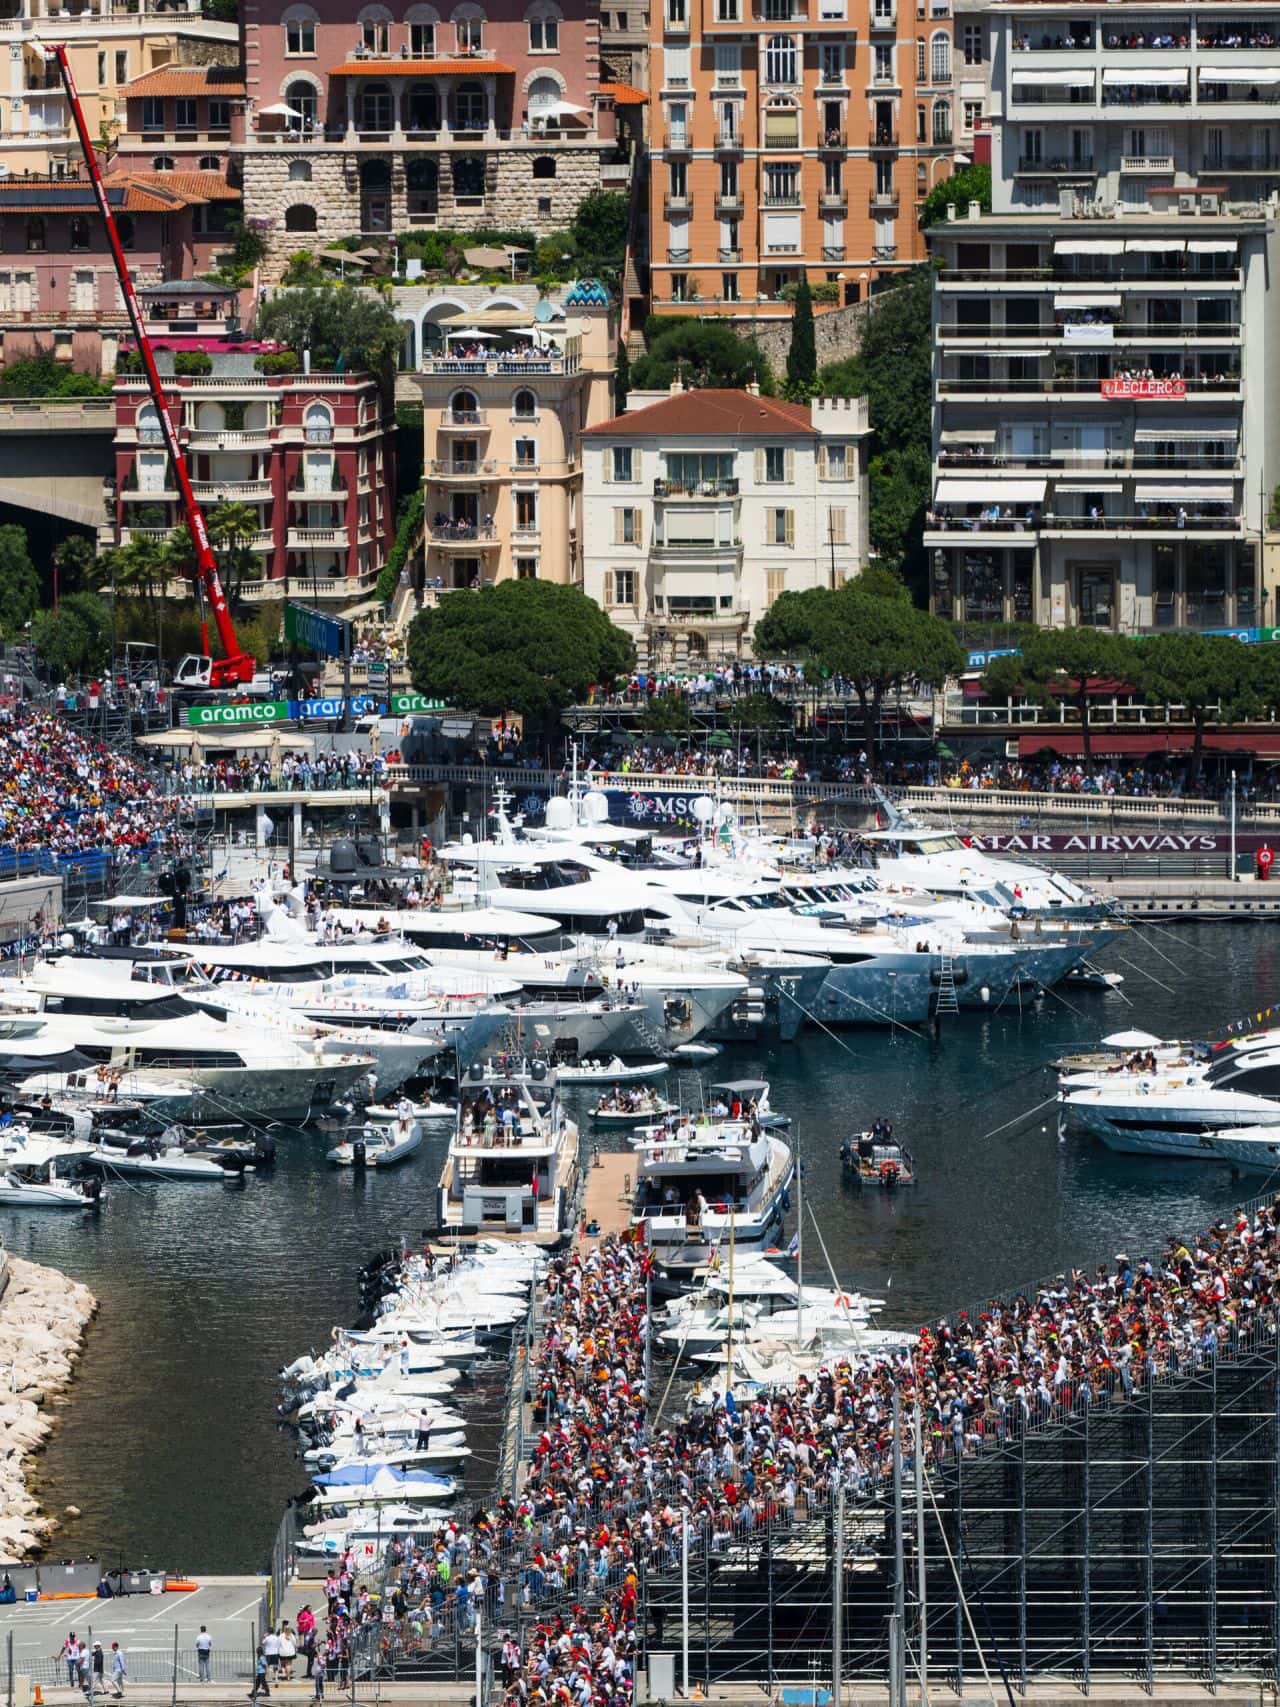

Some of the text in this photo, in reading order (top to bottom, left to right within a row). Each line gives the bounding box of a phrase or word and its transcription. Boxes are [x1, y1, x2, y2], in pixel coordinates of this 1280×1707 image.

[1114, 382, 1173, 394] LECLERC
[200, 703, 276, 722] aramco
[970, 835, 1217, 850] ATAR AIRWAYS
